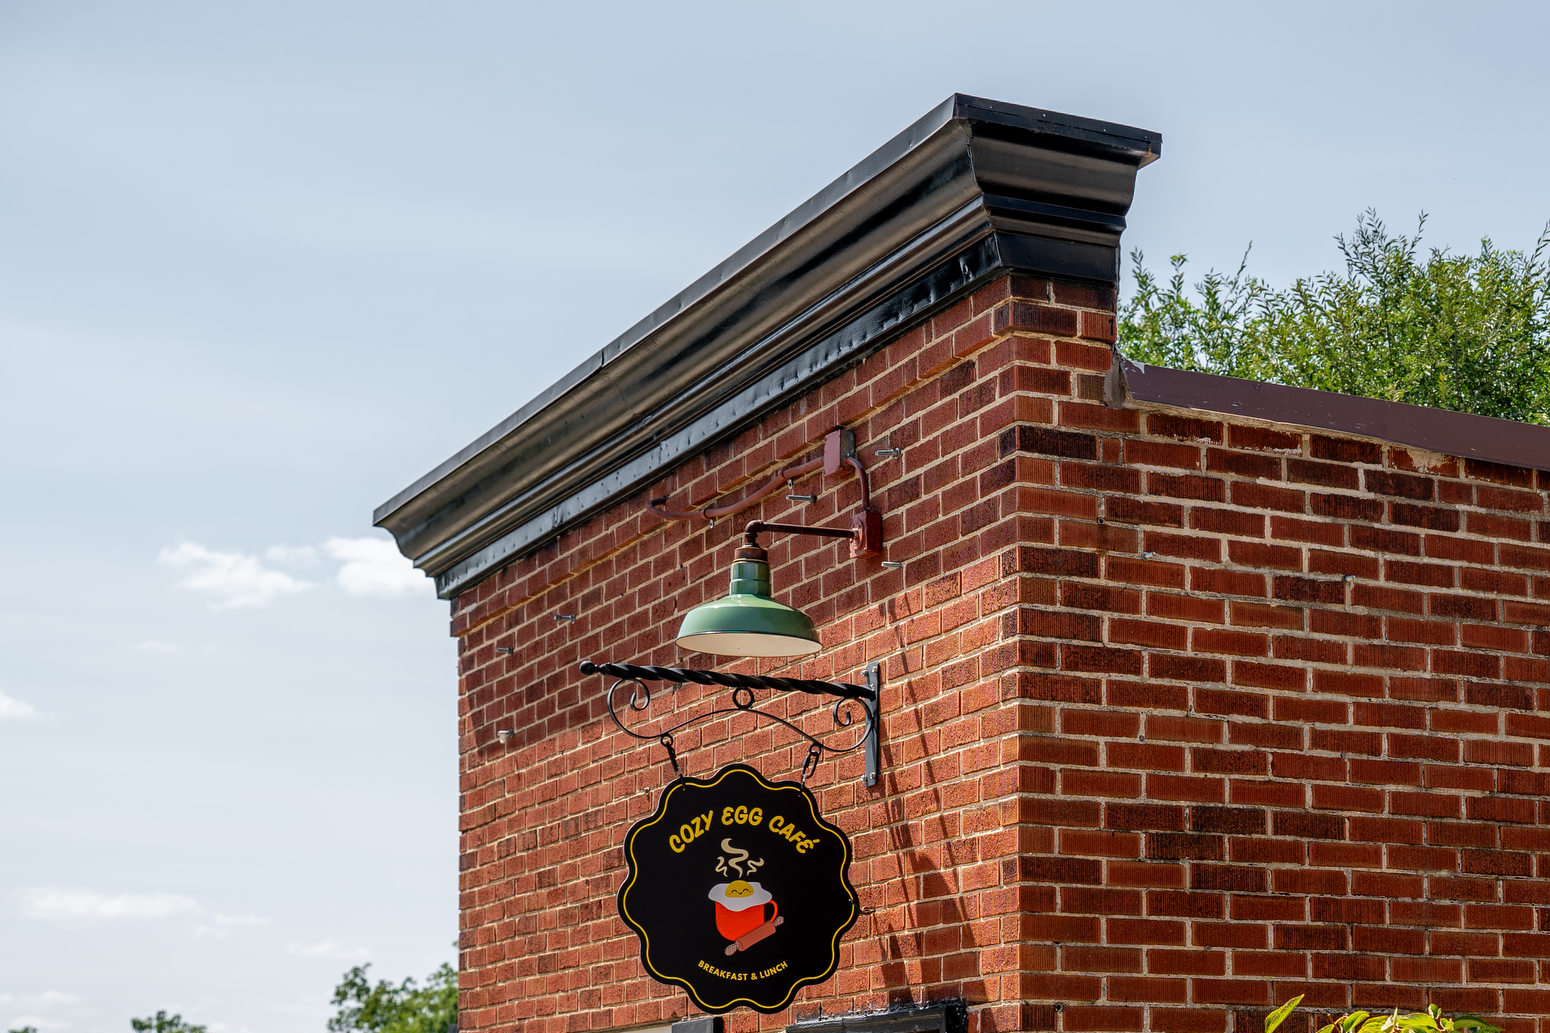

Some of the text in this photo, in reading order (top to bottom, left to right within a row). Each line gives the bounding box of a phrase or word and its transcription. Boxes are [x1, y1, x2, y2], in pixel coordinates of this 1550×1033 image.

[669, 806, 820, 853] COZY EGG CAFÉ
[698, 960, 788, 981] BREAKFAST & LUNCH
